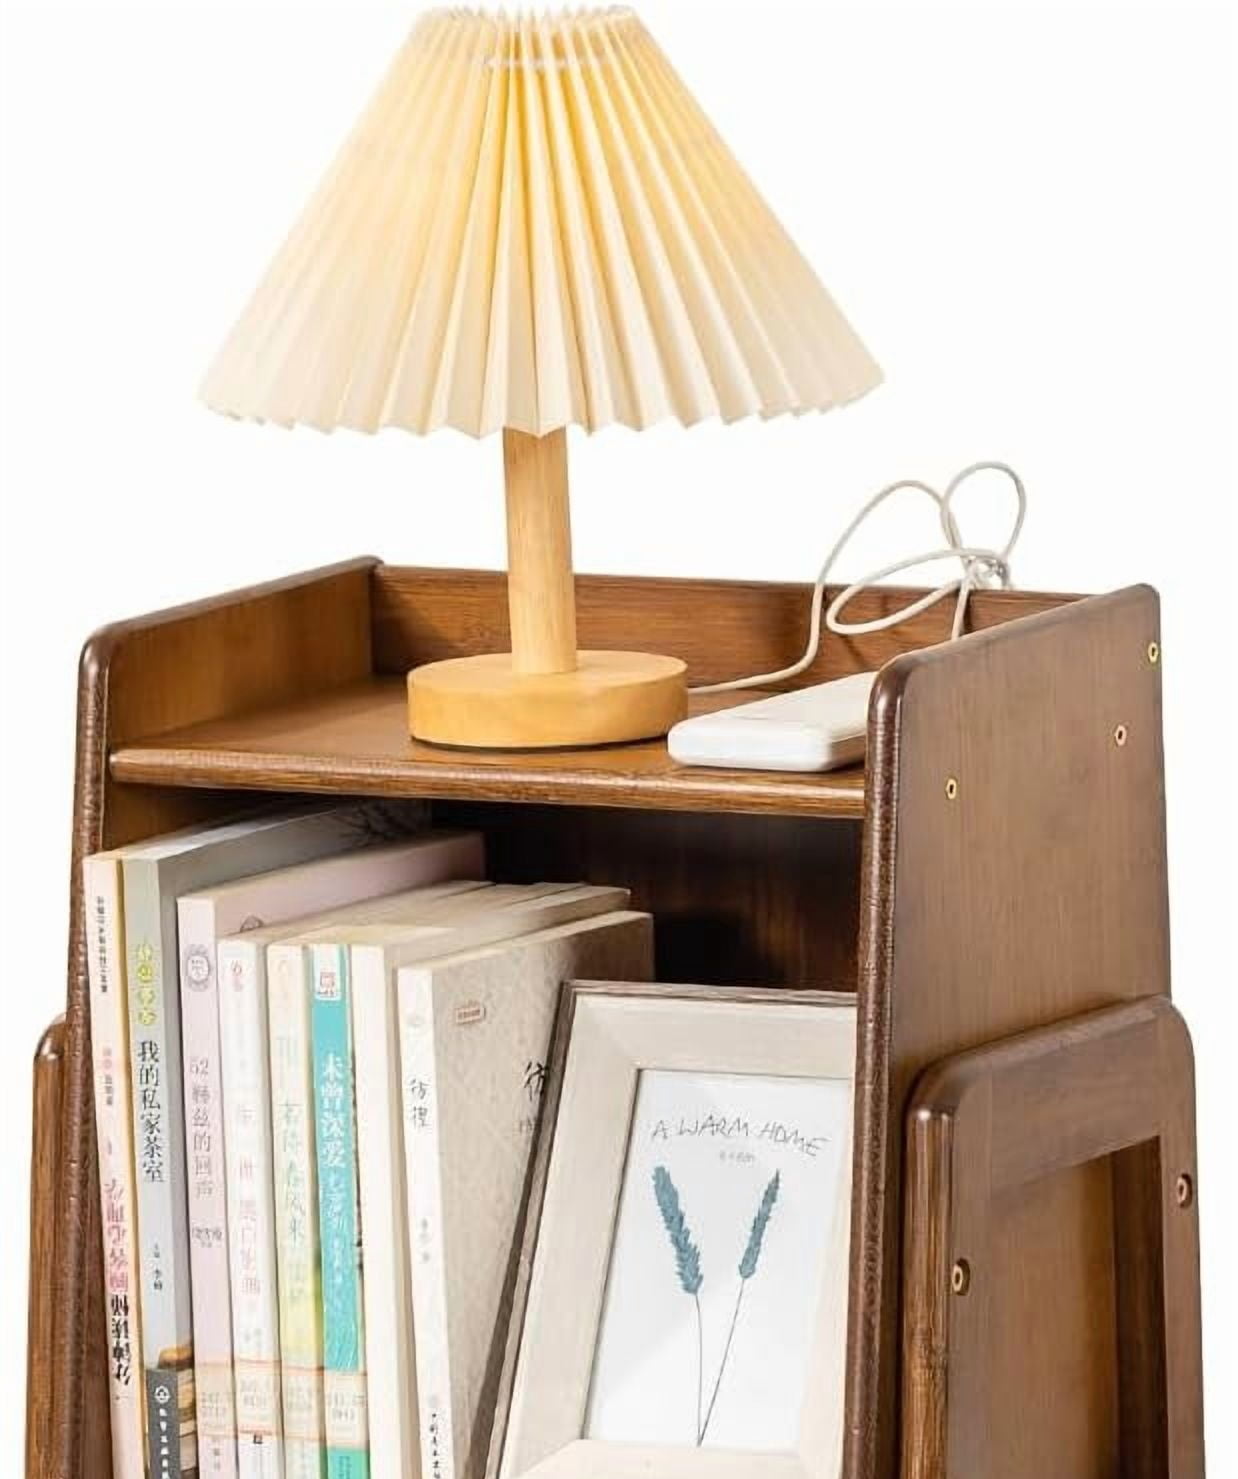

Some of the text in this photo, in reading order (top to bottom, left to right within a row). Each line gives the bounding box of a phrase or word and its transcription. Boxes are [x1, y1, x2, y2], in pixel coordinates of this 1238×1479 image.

[137, 1040, 164, 1183] 我的私家茶室
[410, 1077, 430, 1129] 彷徨
[652, 1119, 669, 1140] A
[679, 1114, 750, 1137] WARM
[760, 1120, 831, 1157] HOME
